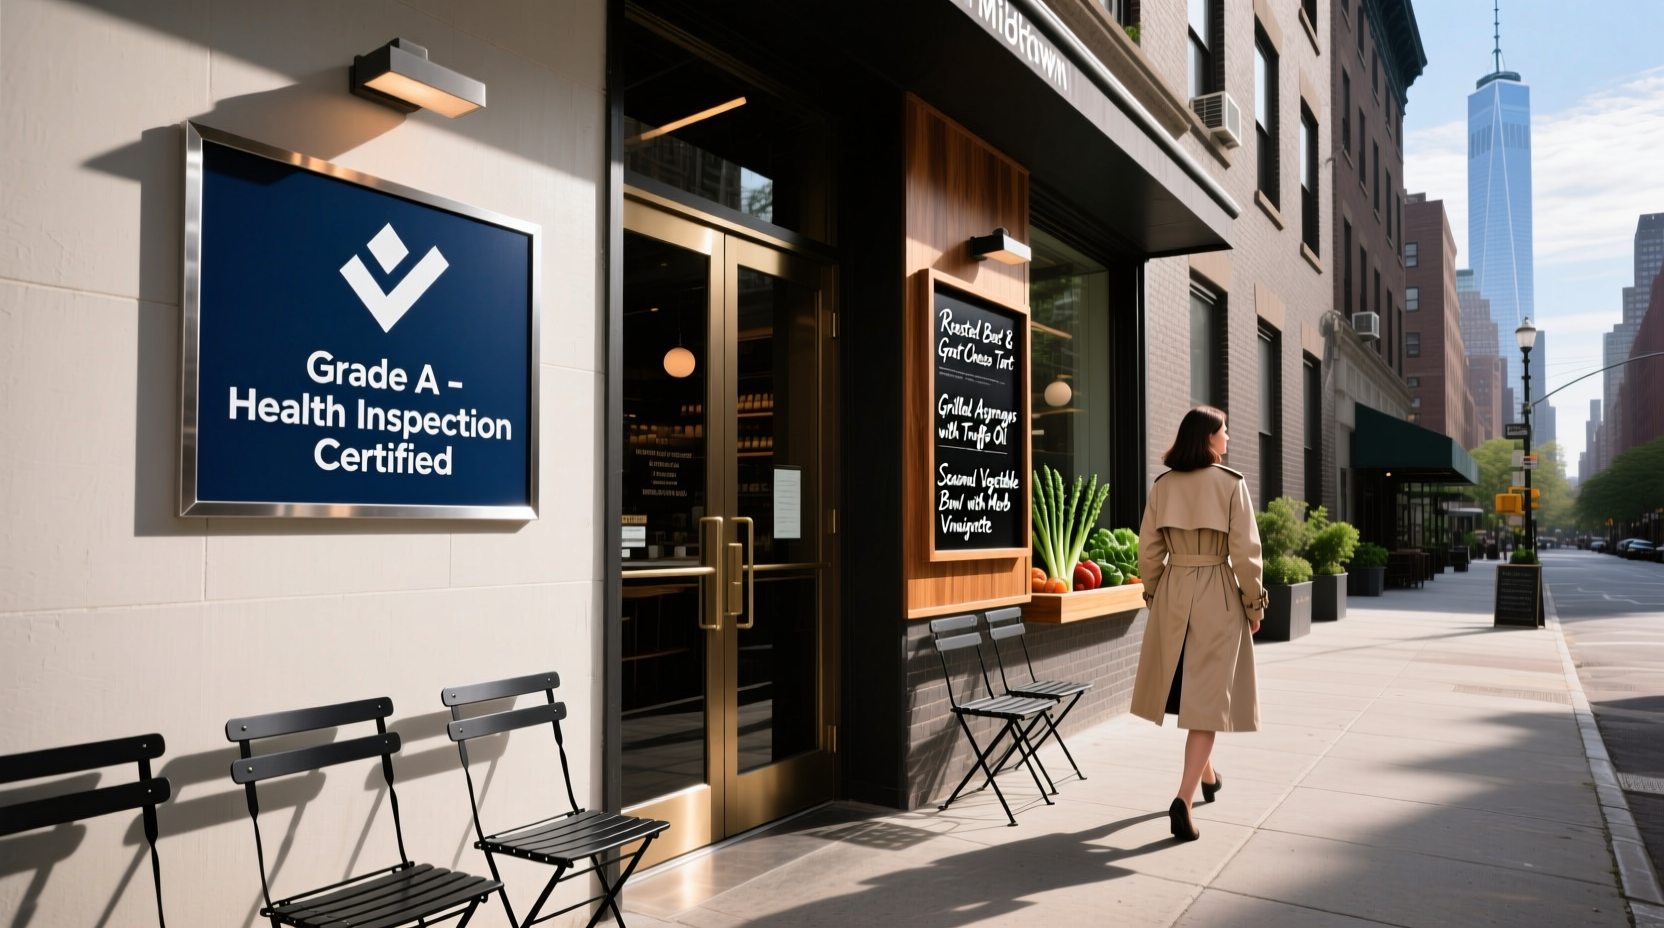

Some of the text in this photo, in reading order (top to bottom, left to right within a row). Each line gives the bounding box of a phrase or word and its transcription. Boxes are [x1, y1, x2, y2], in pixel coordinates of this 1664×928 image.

[306, 350, 408, 391] Grade
[414, 364, 440, 395] A
[229, 386, 512, 440] Health Inspection
[313, 437, 452, 475] Certified
